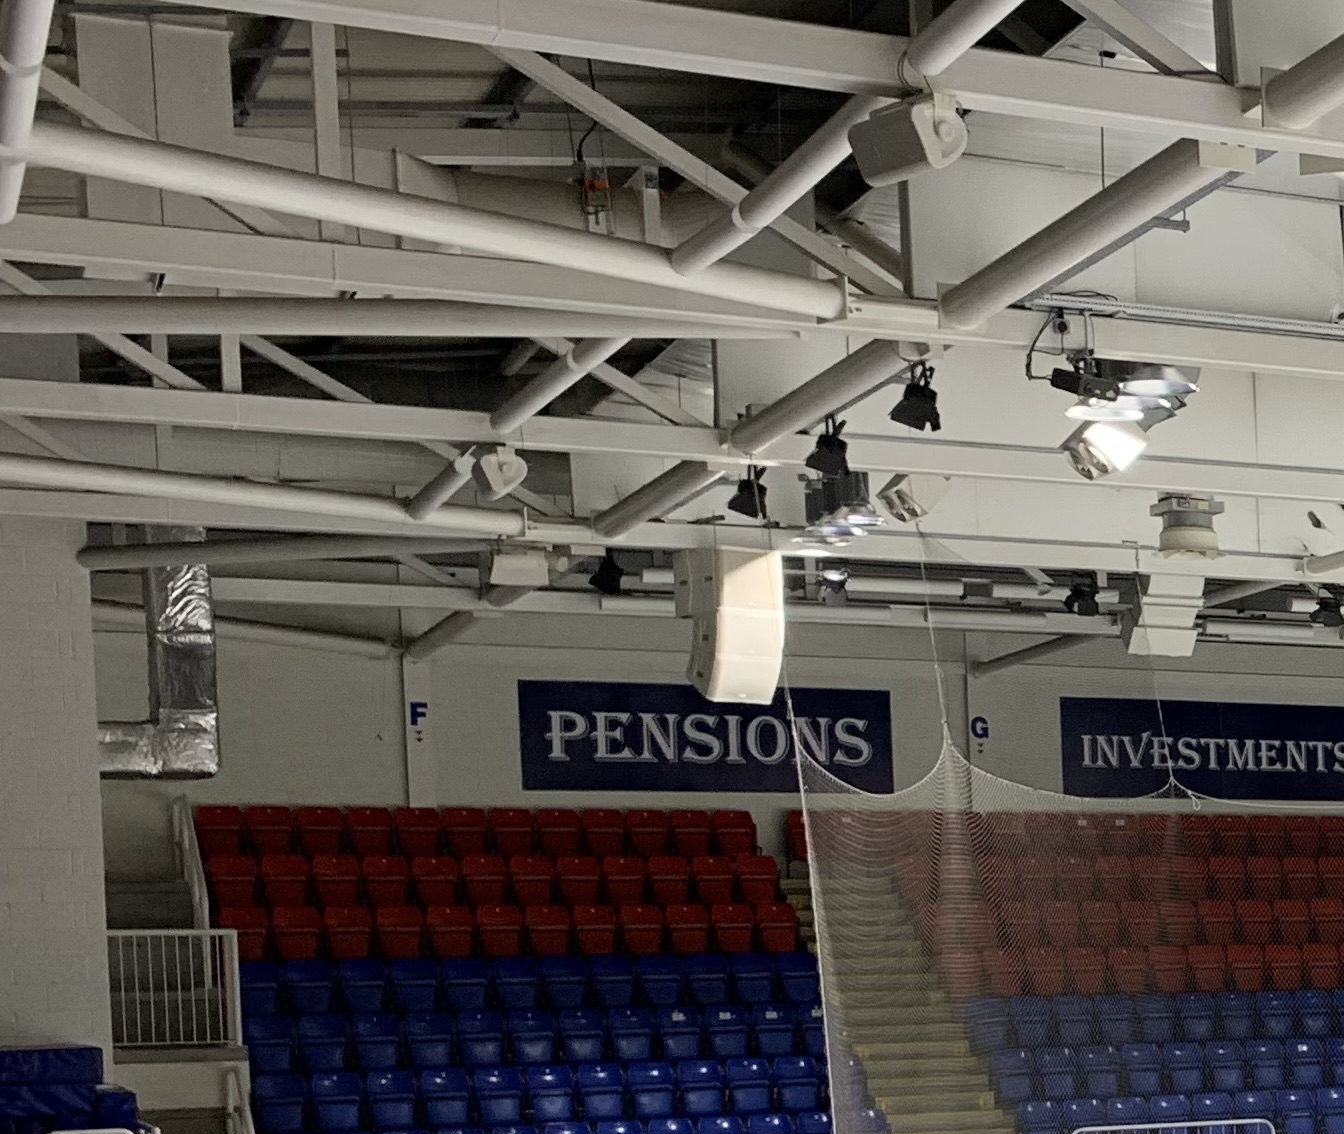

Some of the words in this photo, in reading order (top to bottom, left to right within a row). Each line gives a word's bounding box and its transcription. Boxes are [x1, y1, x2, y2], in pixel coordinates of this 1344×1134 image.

[410, 703, 428, 727] F
[544, 708, 873, 767] PENSIONS
[972, 716, 989, 740] G
